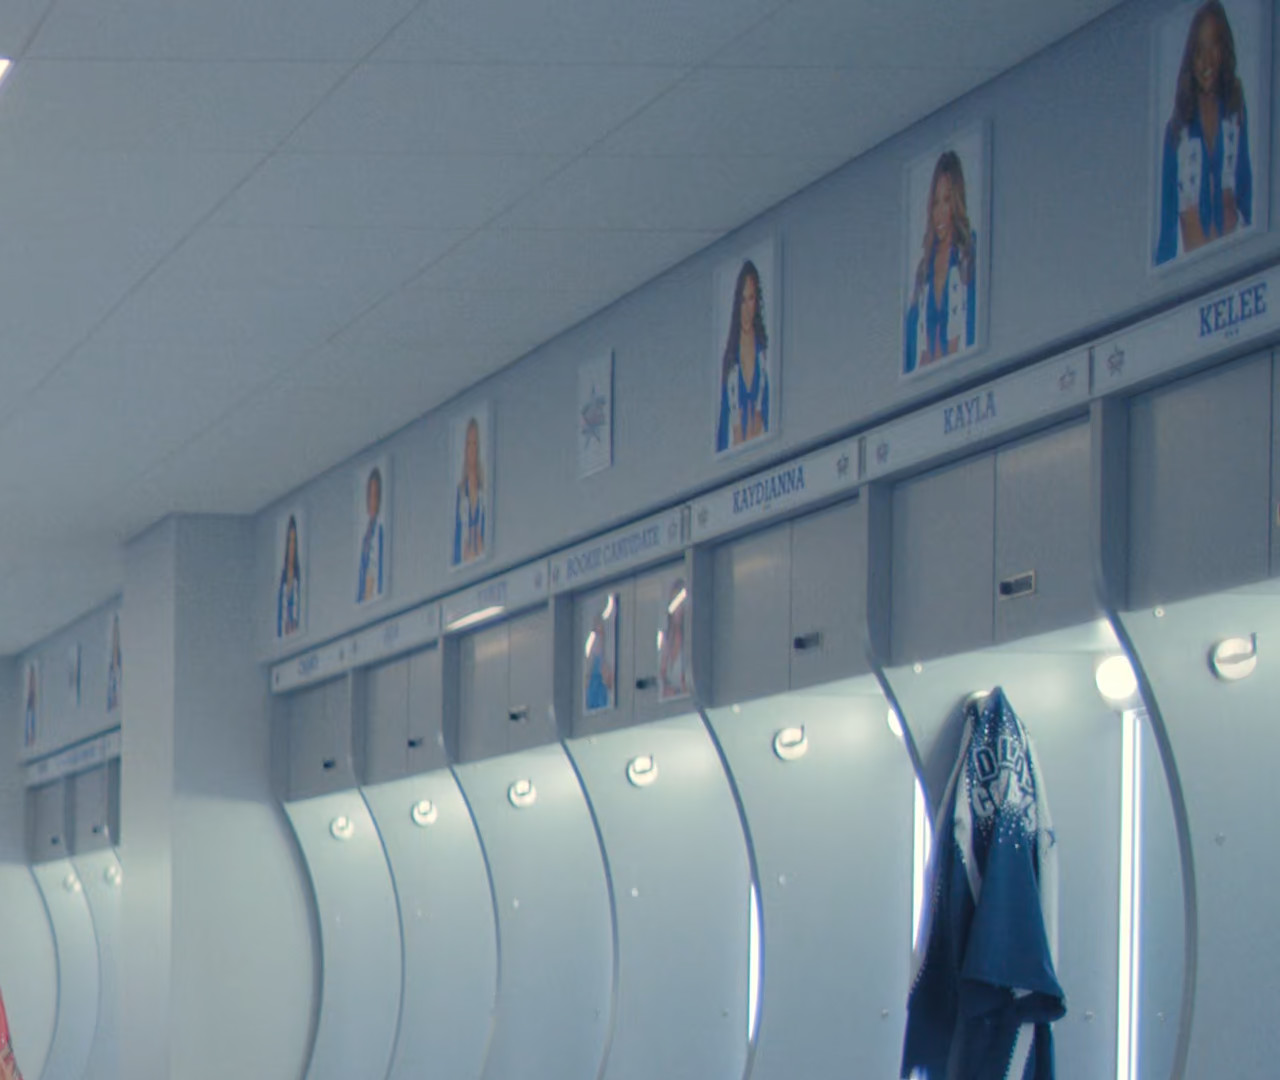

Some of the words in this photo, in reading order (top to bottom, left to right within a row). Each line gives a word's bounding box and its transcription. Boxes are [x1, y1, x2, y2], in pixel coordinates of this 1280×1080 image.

[1200, 282, 1267, 337] KELEE
[943, 391, 997, 435] KAYLA
[733, 465, 805, 514] KAYDIANNA
